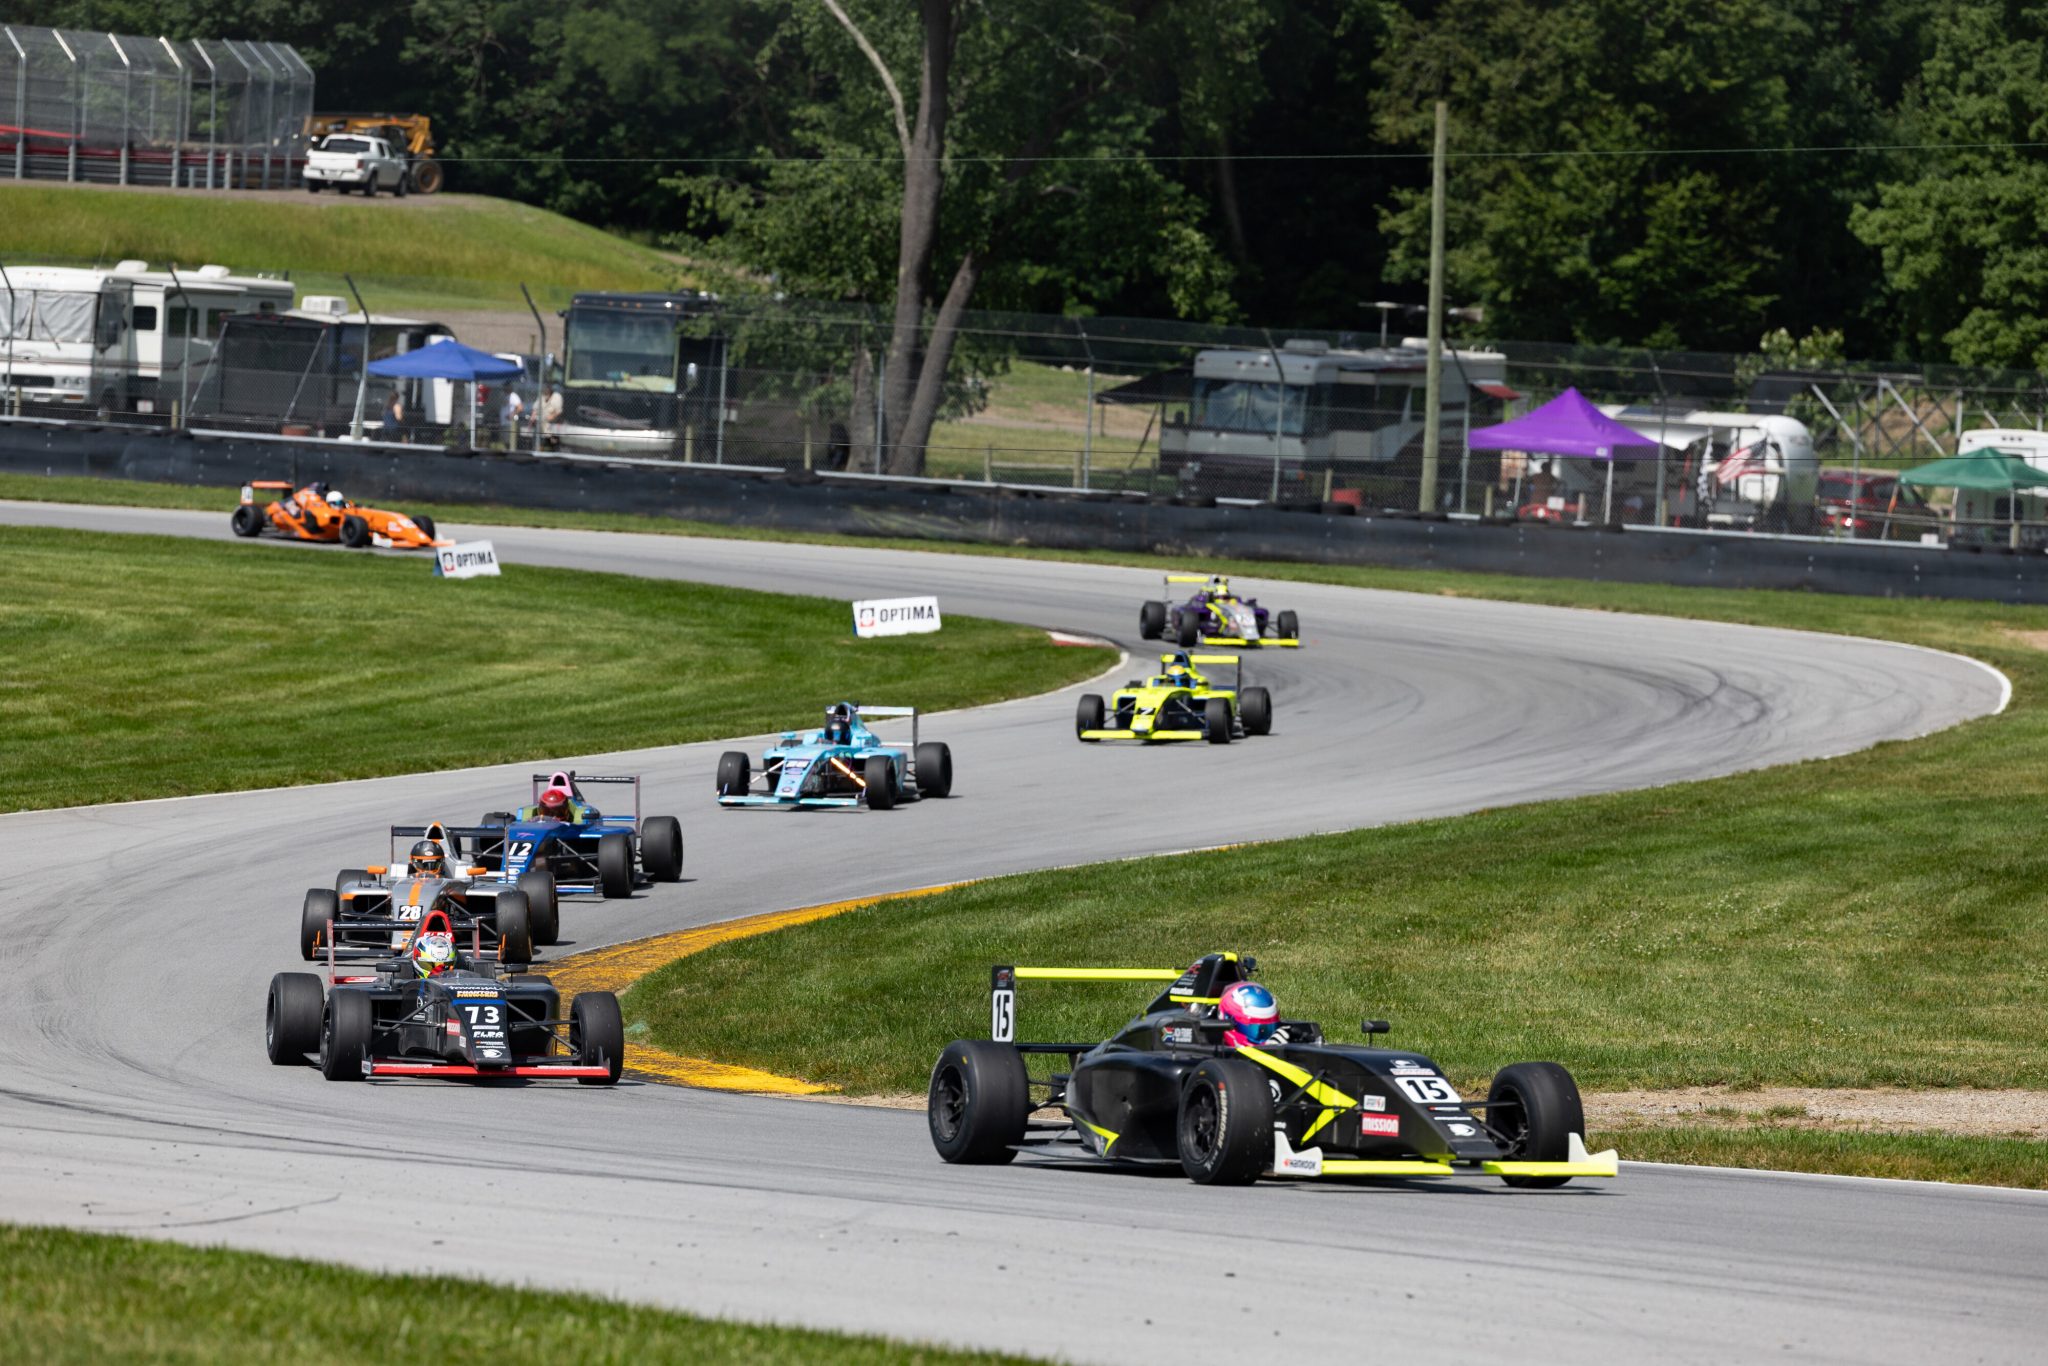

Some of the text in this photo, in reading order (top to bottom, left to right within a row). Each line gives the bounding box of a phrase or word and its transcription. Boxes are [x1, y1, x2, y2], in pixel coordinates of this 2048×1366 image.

[456, 552, 493, 568] OPTIMA
[880, 605, 934, 622] OPTIMA
[509, 842, 532, 856] 12
[399, 905, 421, 920] 28
[464, 1006, 500, 1024] 73
[996, 994, 1010, 1038] 15
[1406, 1080, 1448, 1100] 15
[1362, 1117, 1399, 1133] MISSION
